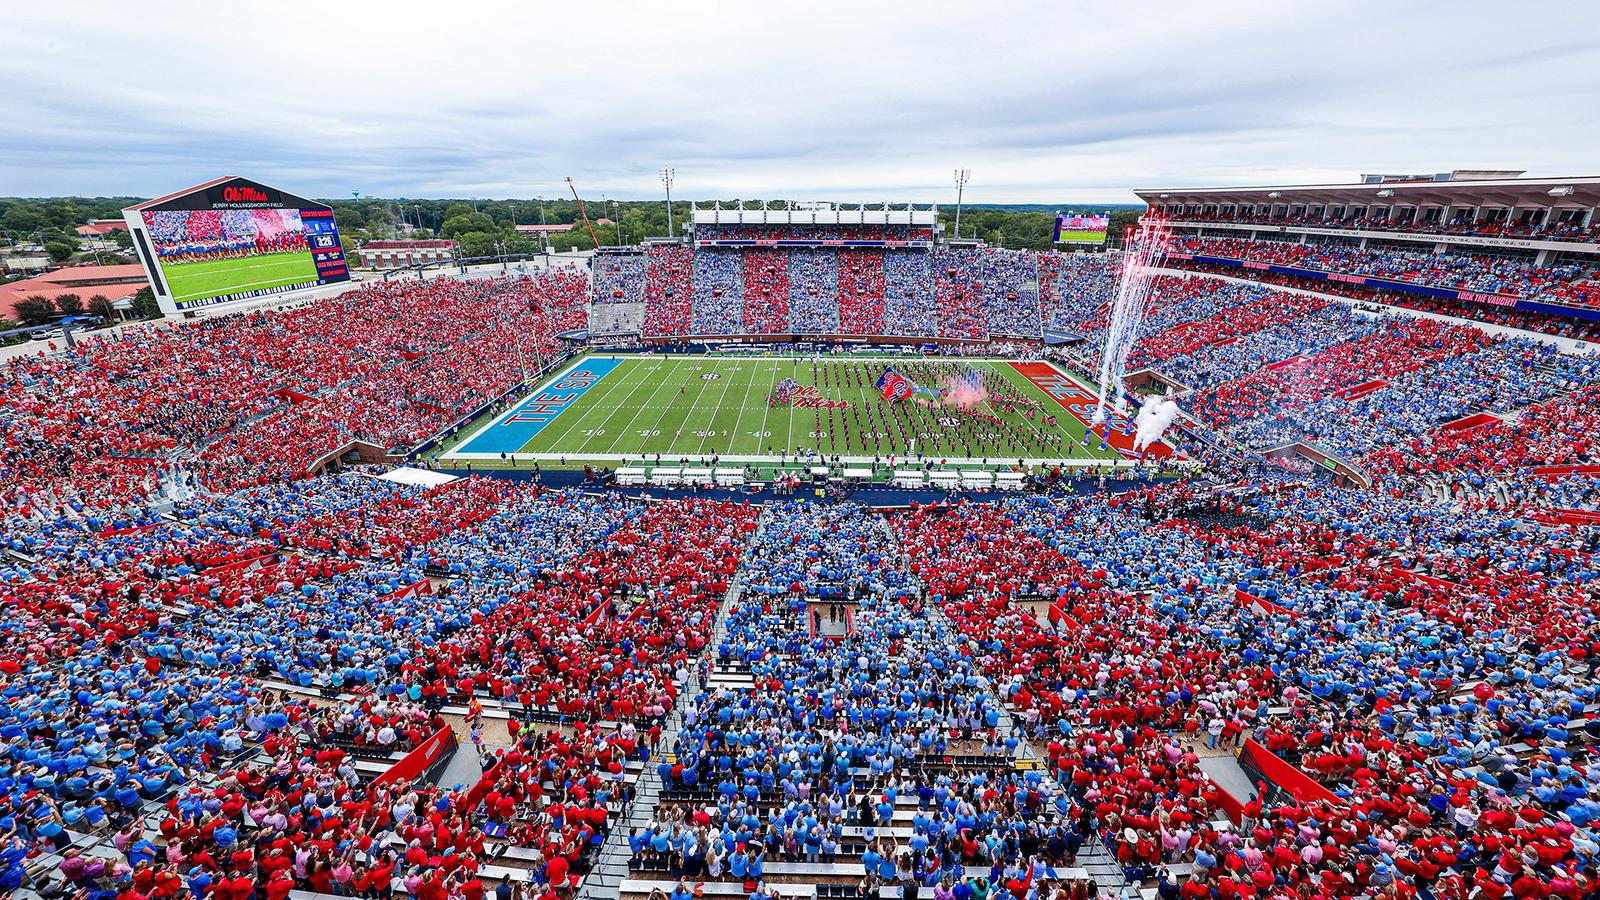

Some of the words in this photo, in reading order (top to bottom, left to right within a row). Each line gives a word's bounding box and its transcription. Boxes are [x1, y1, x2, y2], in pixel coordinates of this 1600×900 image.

[223, 186, 240, 202] Ole
[240, 186, 268, 202] Miss
[182, 297, 217, 310] WELCOME
[219, 294, 229, 303] TO
[1475, 293, 1487, 303] THE
[1031, 374, 1094, 400] THE
[501, 392, 577, 426] THE
[554, 369, 600, 390] SIP
